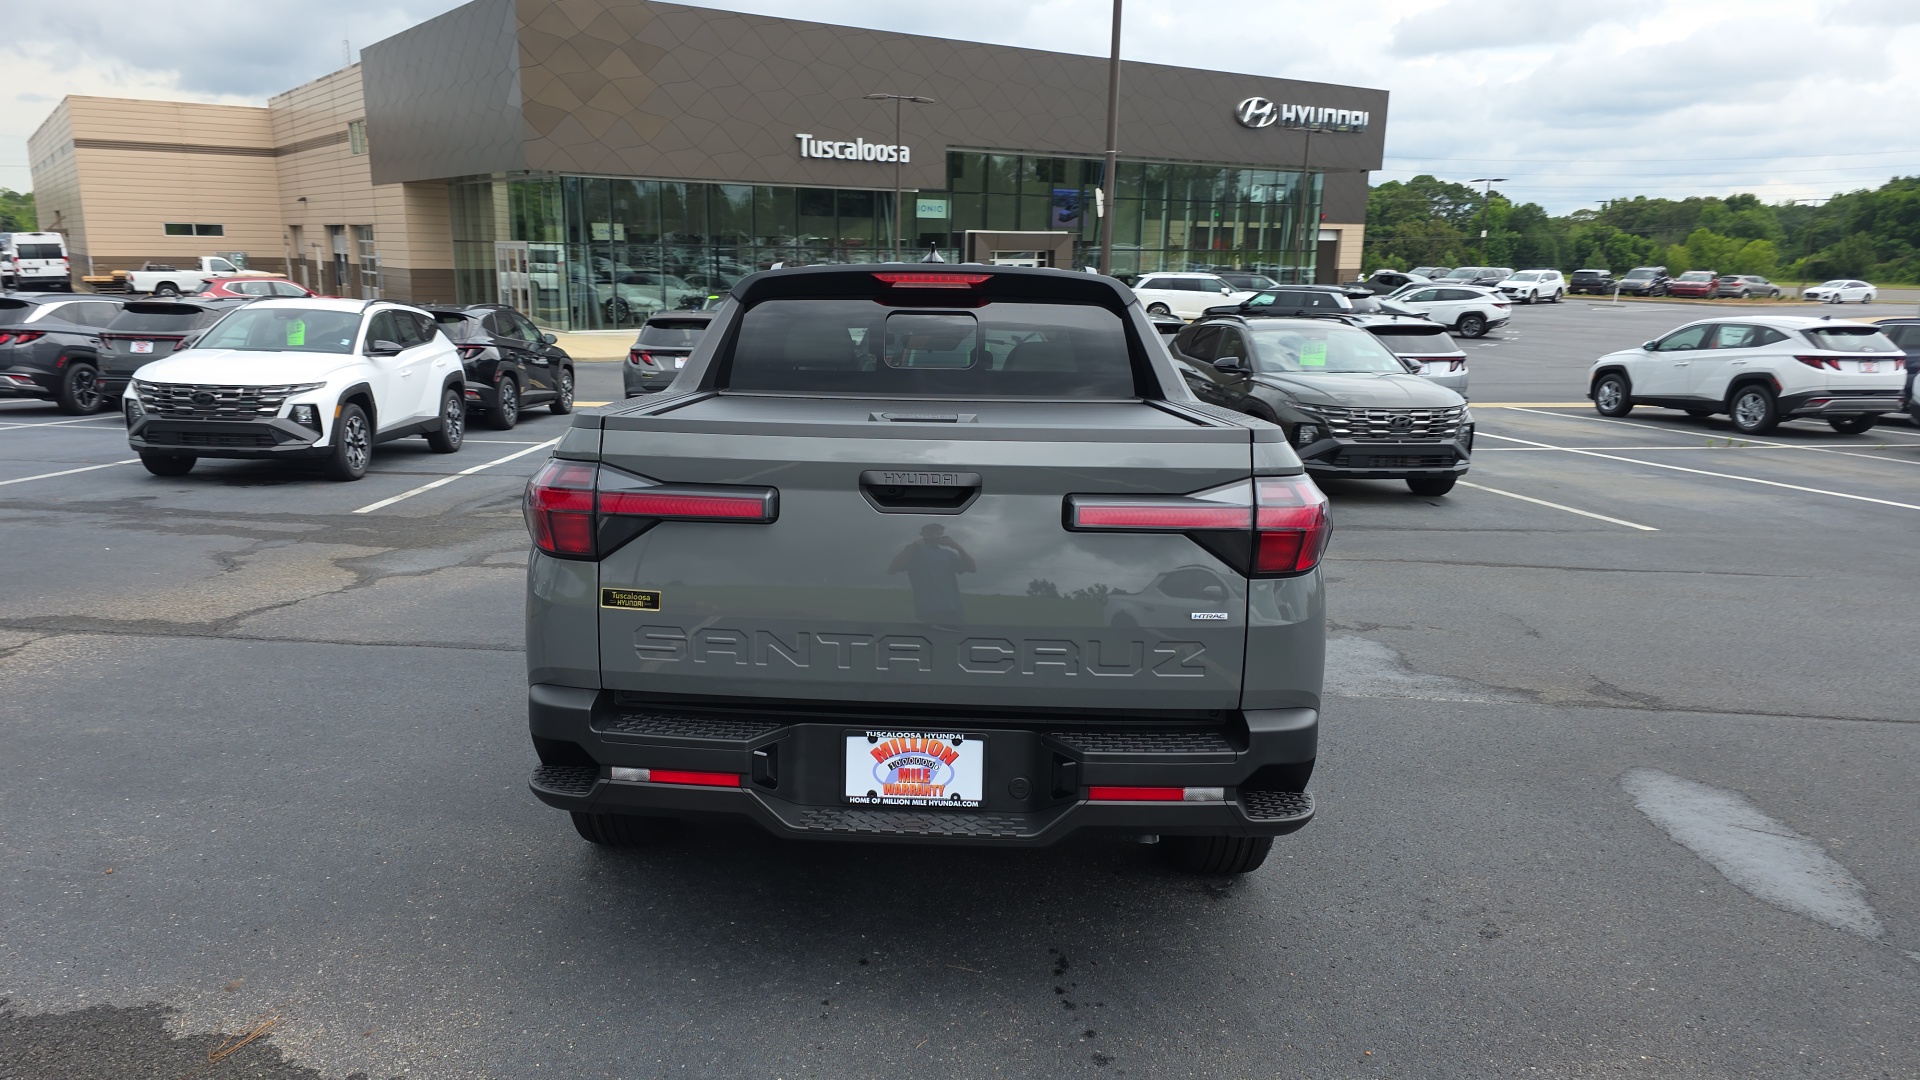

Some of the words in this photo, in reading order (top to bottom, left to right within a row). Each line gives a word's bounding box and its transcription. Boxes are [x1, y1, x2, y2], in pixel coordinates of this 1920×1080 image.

[1280, 103, 1369, 131] HYUNDAI
[795, 133, 910, 163] Tuscaloosa
[884, 472, 958, 485] HYUNDAI
[611, 591, 651, 601] Tuscaloosa
[617, 599, 644, 607] HYUNDAI
[634, 625, 932, 672] SANTA
[958, 637, 1206, 677] CRUZ
[866, 731, 922, 739] TUSCALOOSA
[870, 738, 960, 766] MILLION
[897, 768, 930, 784] MILE
[883, 783, 945, 797] WARRANTY
[883, 798, 910, 806] MILLION
[929, 800, 979, 808] HYUNDAI.COM
